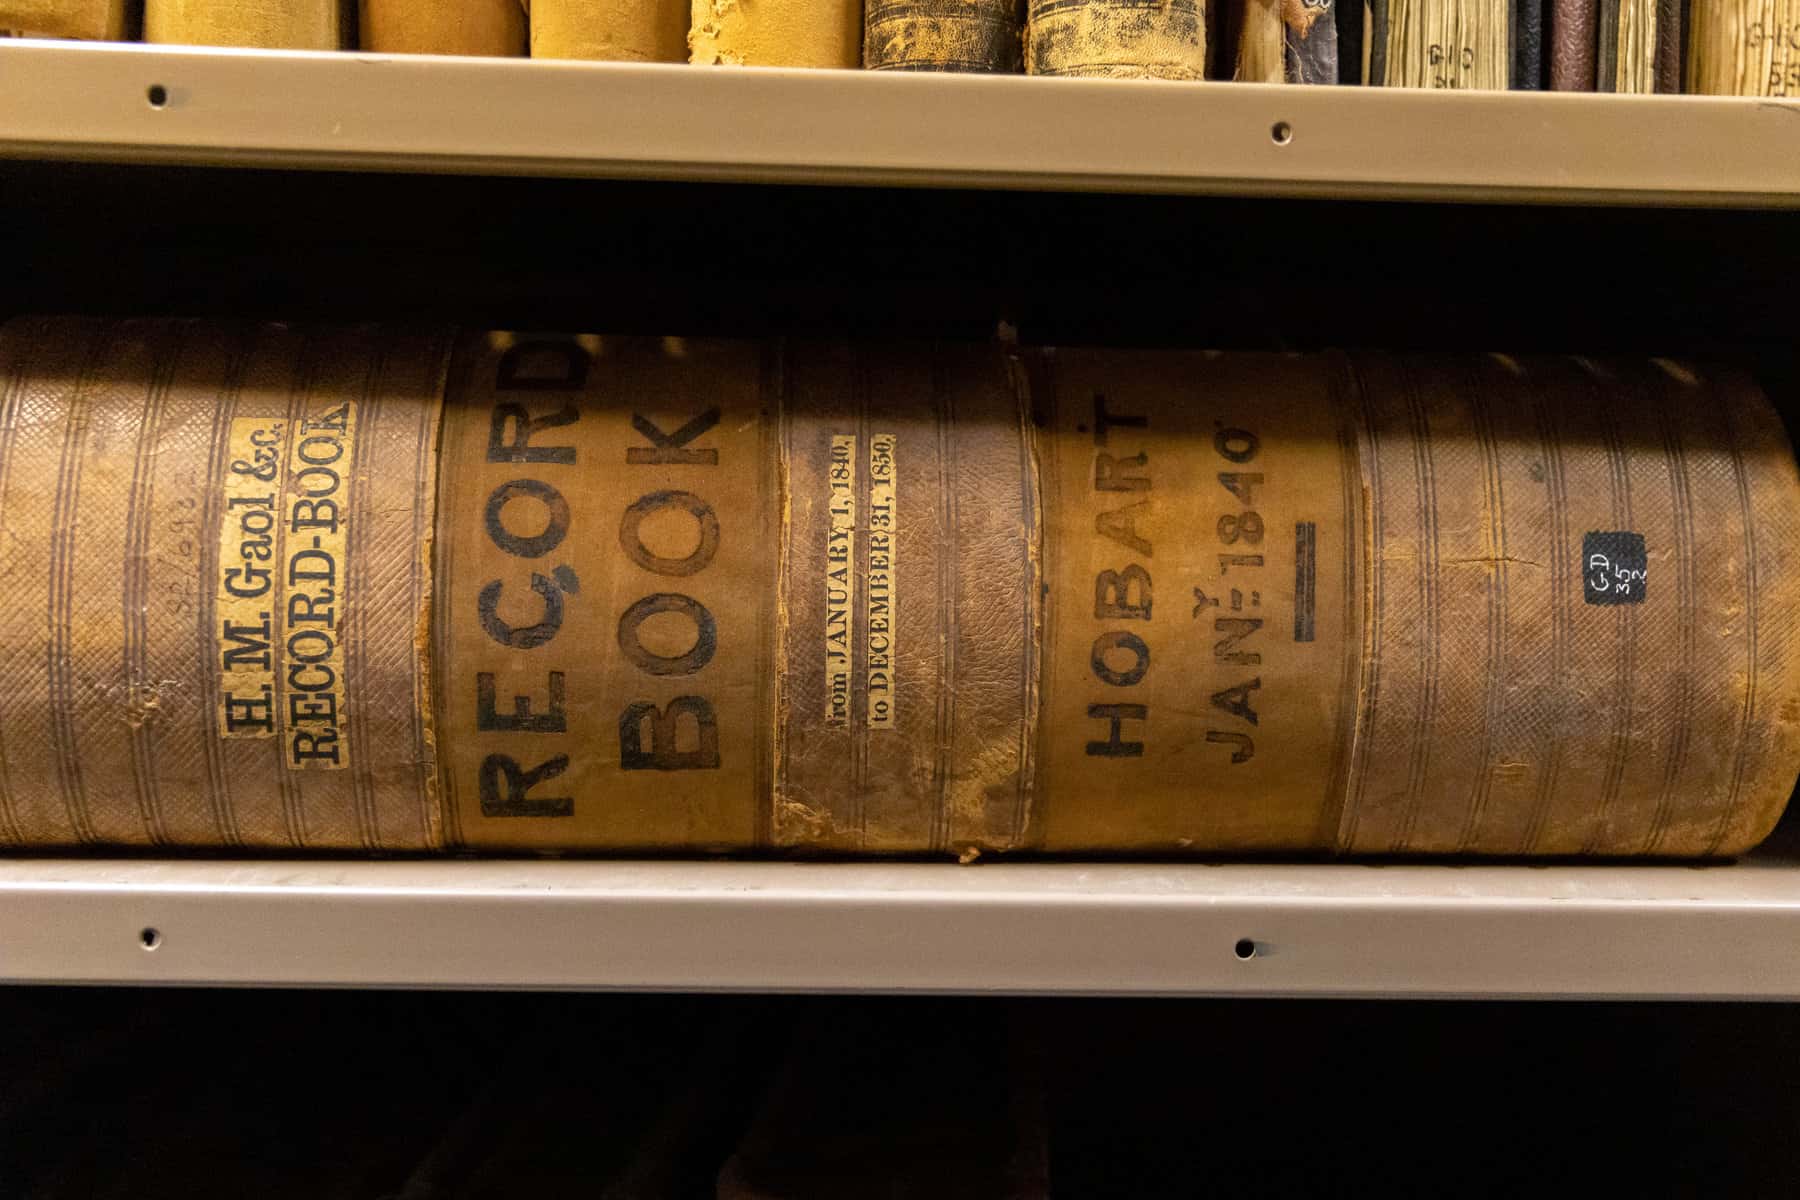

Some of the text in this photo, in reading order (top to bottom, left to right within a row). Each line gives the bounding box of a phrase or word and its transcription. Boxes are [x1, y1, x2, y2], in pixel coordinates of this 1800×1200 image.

[224, 494, 274, 598] Gaol
[834, 500, 852, 516] 1,
[871, 496, 892, 526] 31,
[287, 401, 349, 764] RECORD-BOOK
[477, 339, 588, 817] RECORD
[617, 405, 720, 771] BOOK
[827, 528, 848, 664] JANUARY
[1086, 395, 1153, 757] HOBART
[1590, 553, 1609, 591] GD
[1615, 564, 1630, 594] 35
[224, 613, 270, 671] M.
[869, 536, 890, 692] DECEMBER
[225, 684, 272, 733] H.
[871, 701, 888, 721] to
